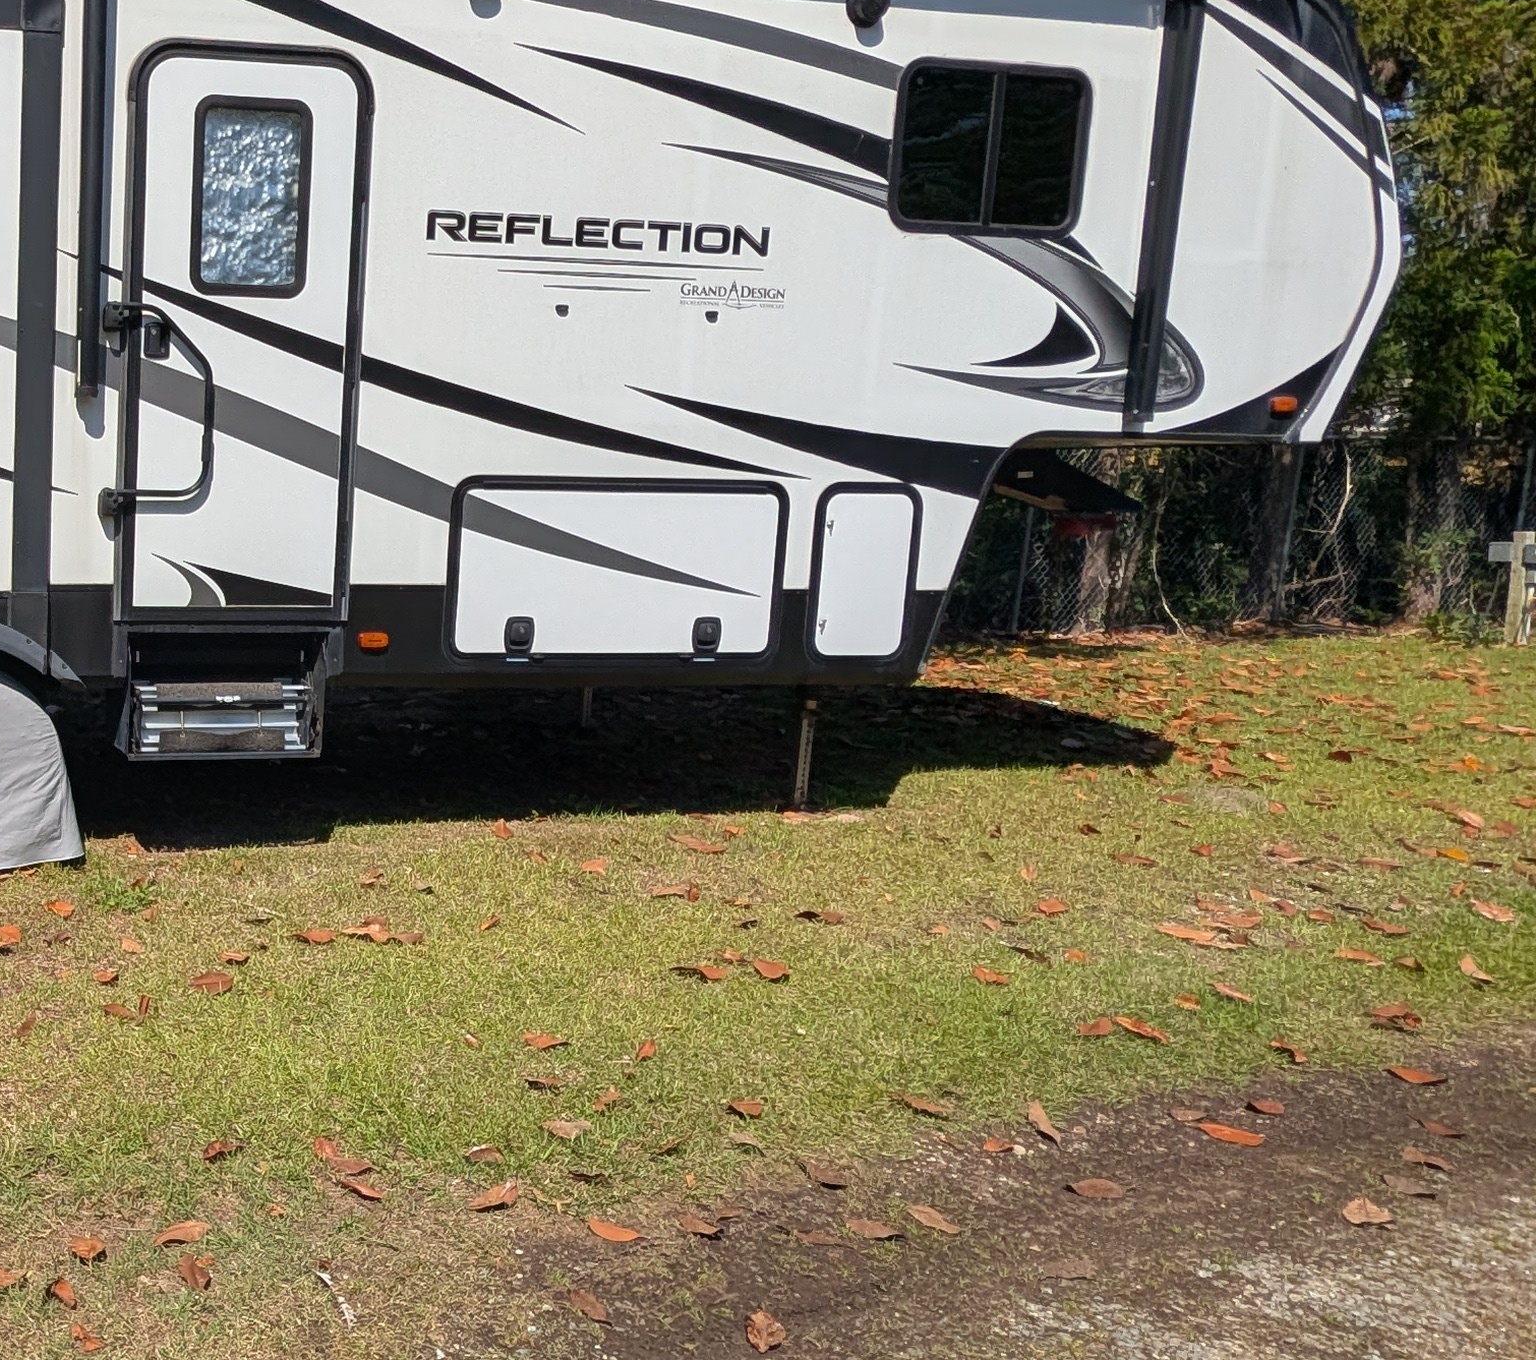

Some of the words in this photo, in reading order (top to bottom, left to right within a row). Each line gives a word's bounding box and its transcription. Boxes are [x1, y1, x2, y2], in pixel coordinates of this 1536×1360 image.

[426, 209, 771, 258] REFLECTION
[680, 283, 727, 297] GRAND
[740, 285, 786, 300] DESIGN
